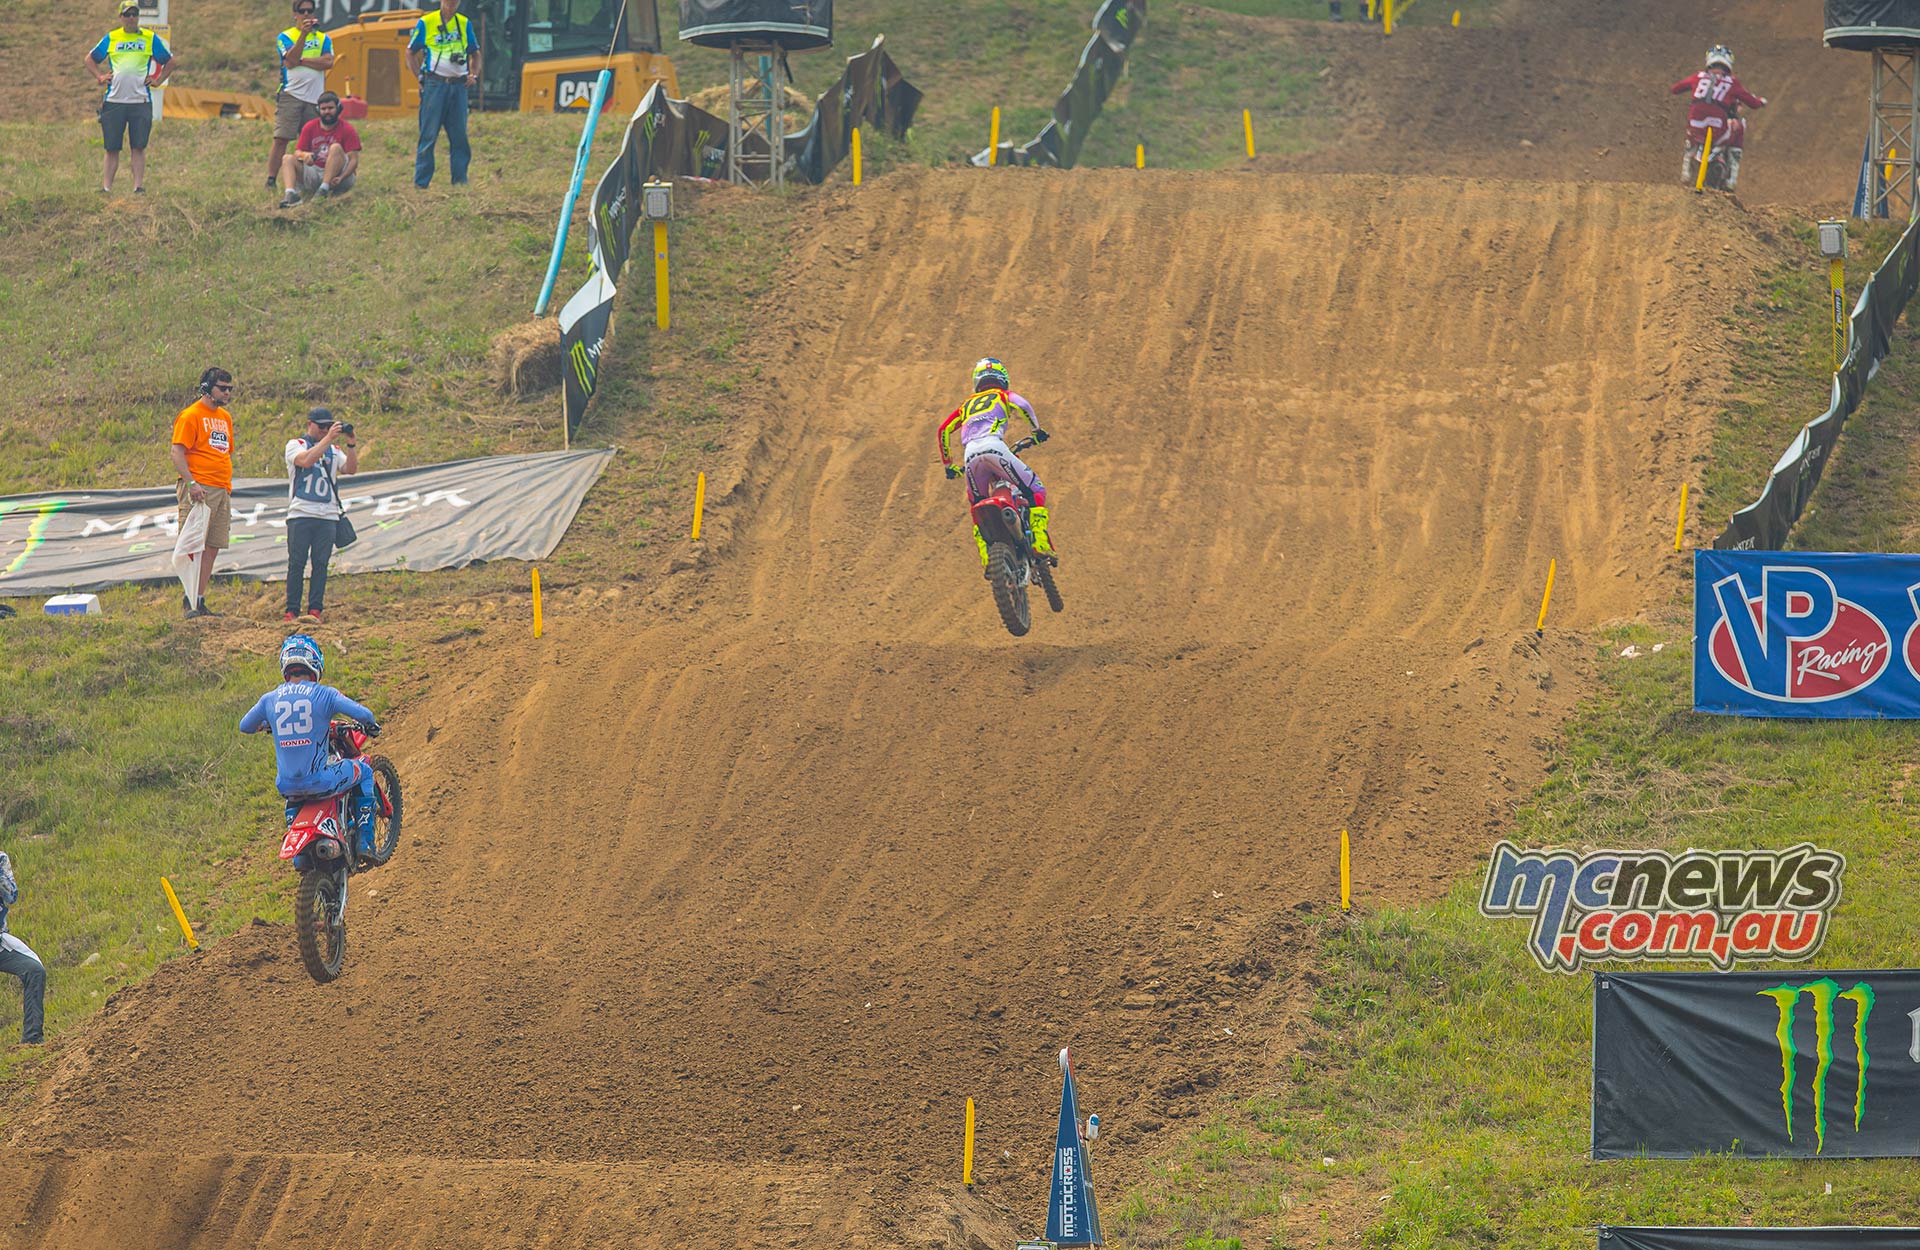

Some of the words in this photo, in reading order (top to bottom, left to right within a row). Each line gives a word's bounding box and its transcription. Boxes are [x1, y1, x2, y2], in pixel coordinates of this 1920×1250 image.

[559, 80, 598, 108] CAT
[303, 473, 329, 497] 10
[1711, 565, 1839, 698] VP
[1796, 639, 1887, 686] Racing
[276, 682, 313, 699] SEXTON
[274, 699, 313, 736] 23
[279, 738, 312, 748] HONDA
[1063, 1147, 1074, 1237] MOTOCROSS
